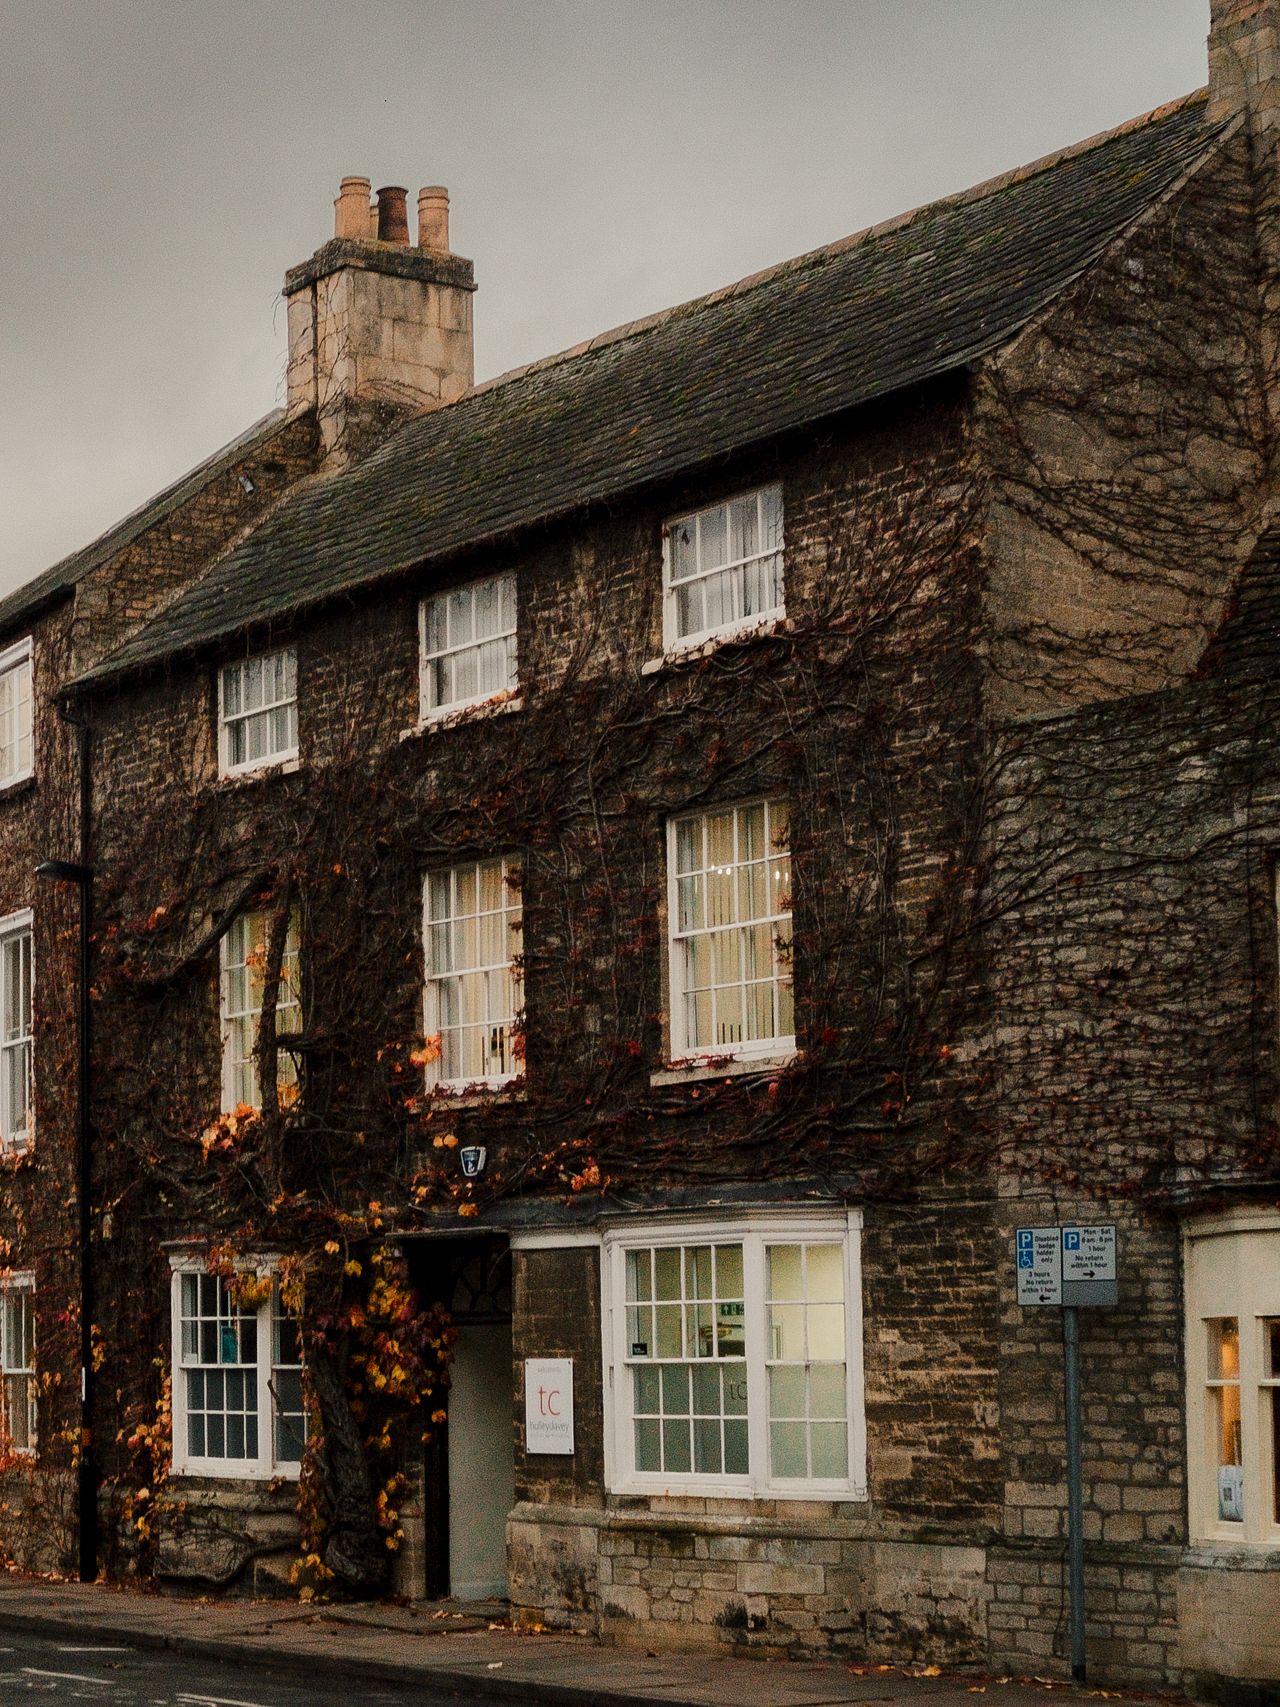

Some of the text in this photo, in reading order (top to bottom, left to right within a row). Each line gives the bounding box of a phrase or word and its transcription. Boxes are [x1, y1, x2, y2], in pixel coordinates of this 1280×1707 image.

[1021, 1233, 1032, 1248] P
[1068, 1234, 1078, 1249] P
[538, 1386, 561, 1416] tc
